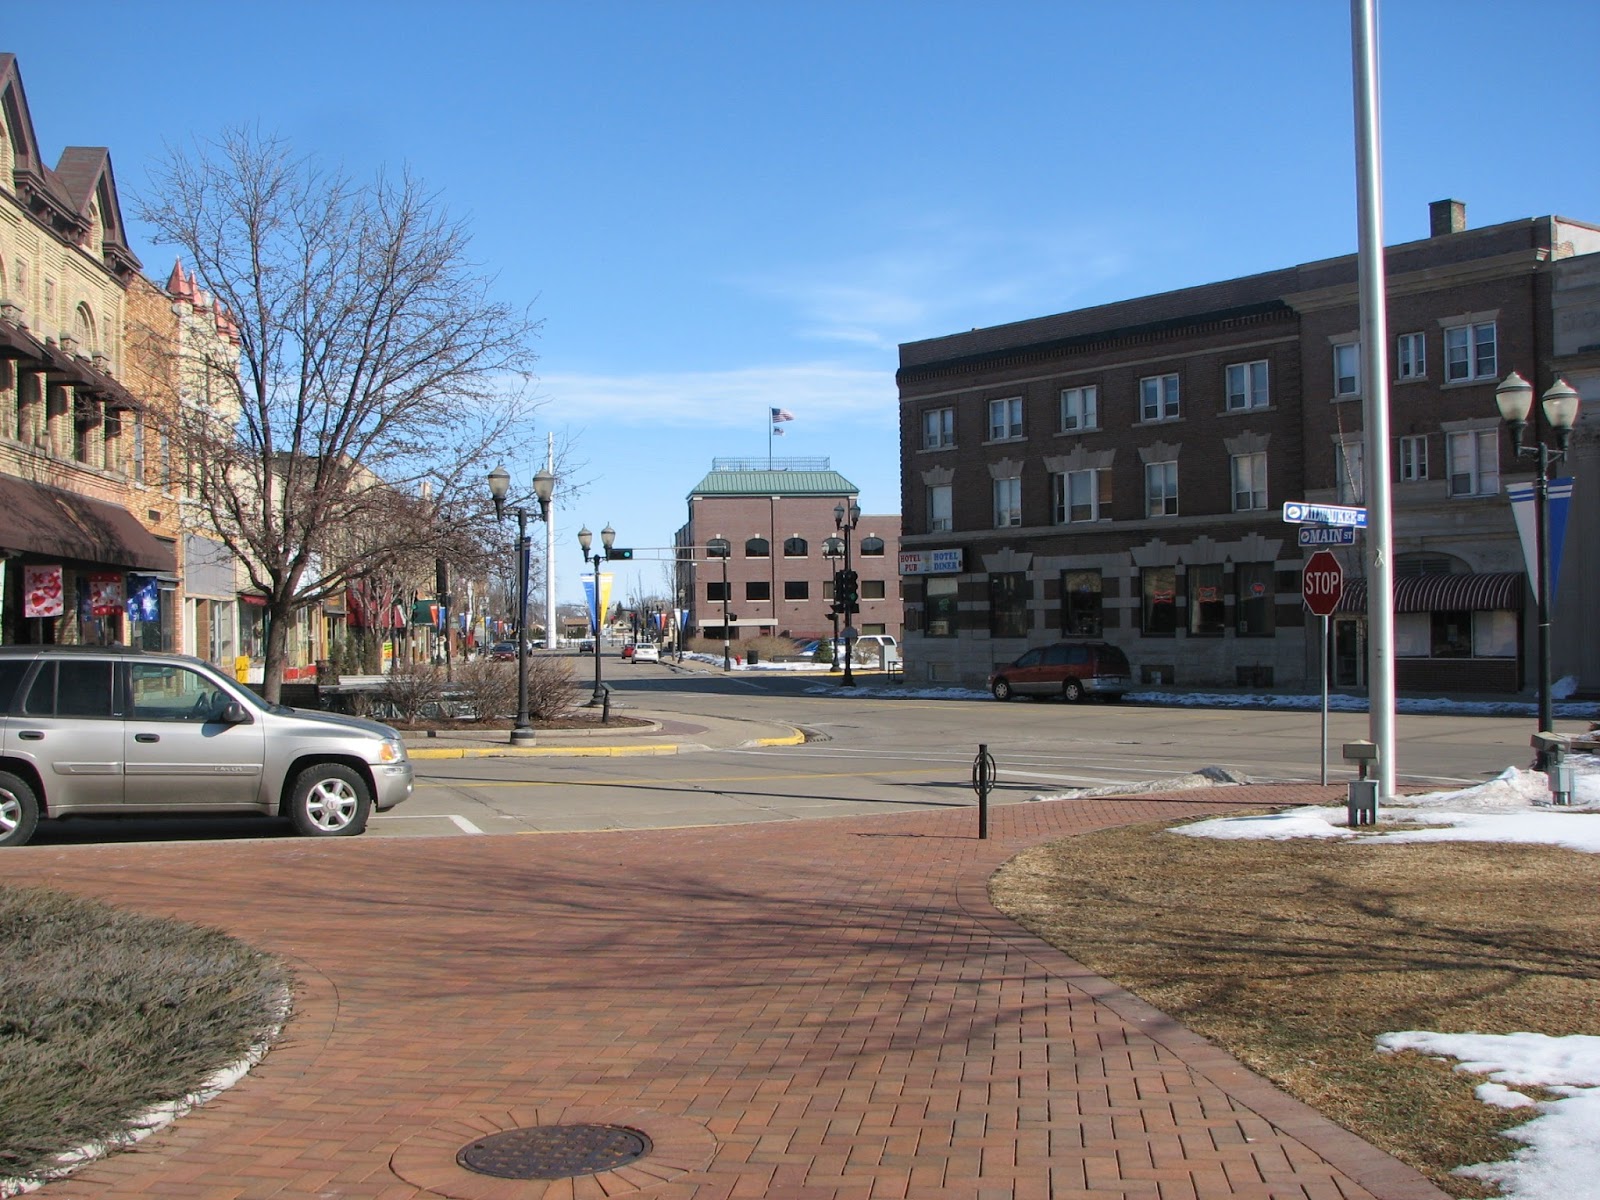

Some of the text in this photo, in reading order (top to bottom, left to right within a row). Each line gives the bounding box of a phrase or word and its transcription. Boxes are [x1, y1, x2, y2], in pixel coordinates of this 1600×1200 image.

[1301, 506, 1365, 524] MILWAUKEE ST
[1309, 528, 1352, 543] MAIN ST
[900, 554, 921, 562] HOTEL
[934, 552, 958, 560] HOTEL
[934, 562, 957, 571] DINER
[1305, 571, 1339, 595] STOP
